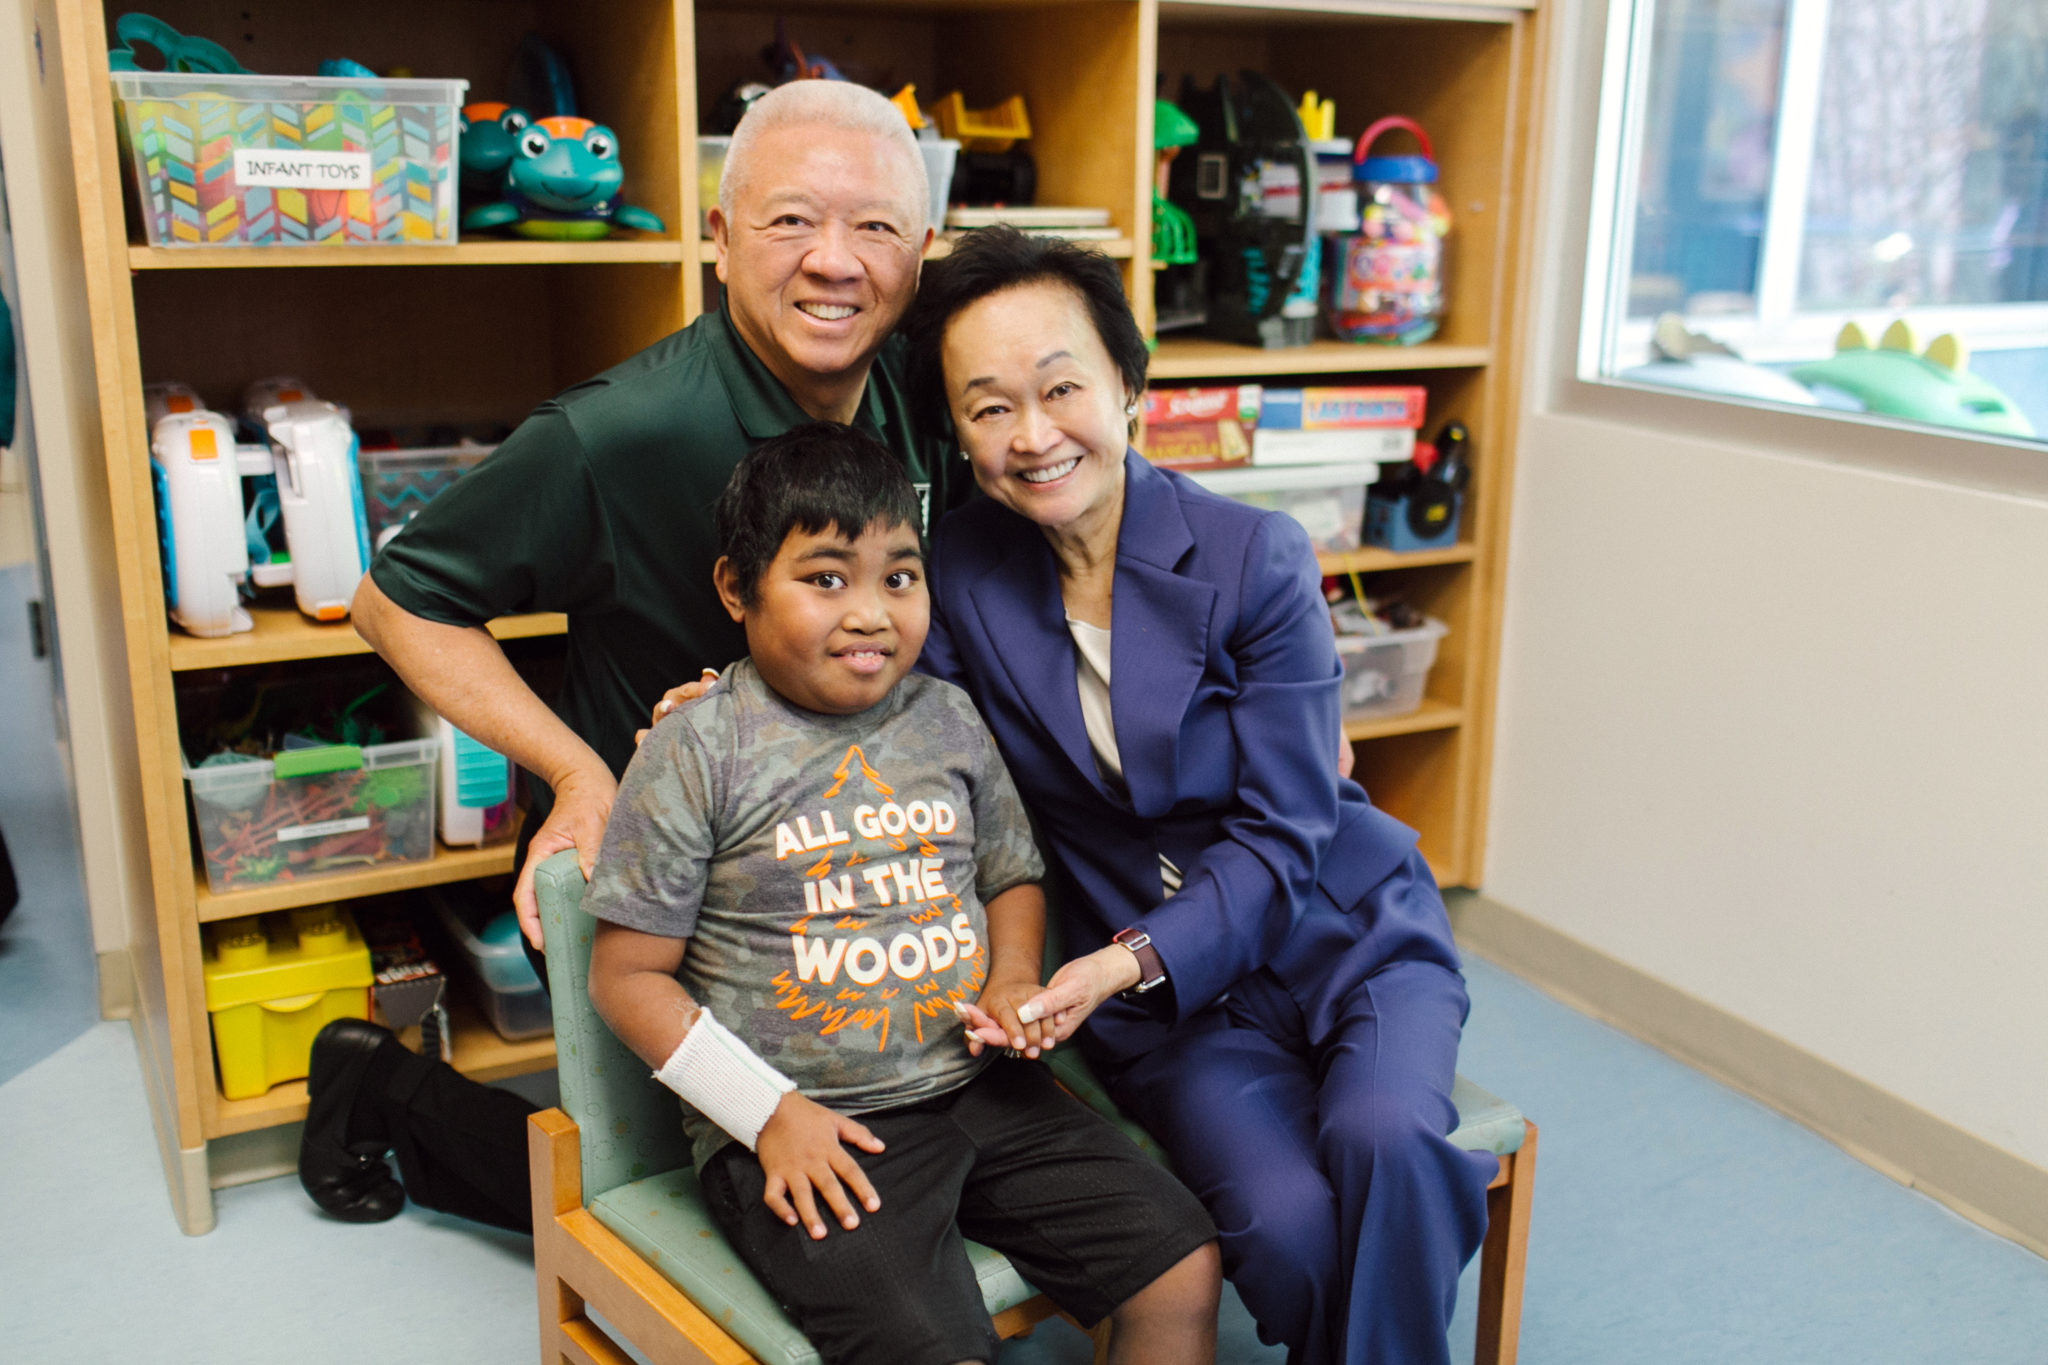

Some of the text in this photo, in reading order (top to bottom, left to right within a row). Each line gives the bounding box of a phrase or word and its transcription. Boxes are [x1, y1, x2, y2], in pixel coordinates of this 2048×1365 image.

[247, 160, 361, 180] INFANT TOYS
[775, 800, 956, 860] ALL GOOD
[804, 858, 948, 913] IN THE
[792, 913, 977, 986] WOODS
